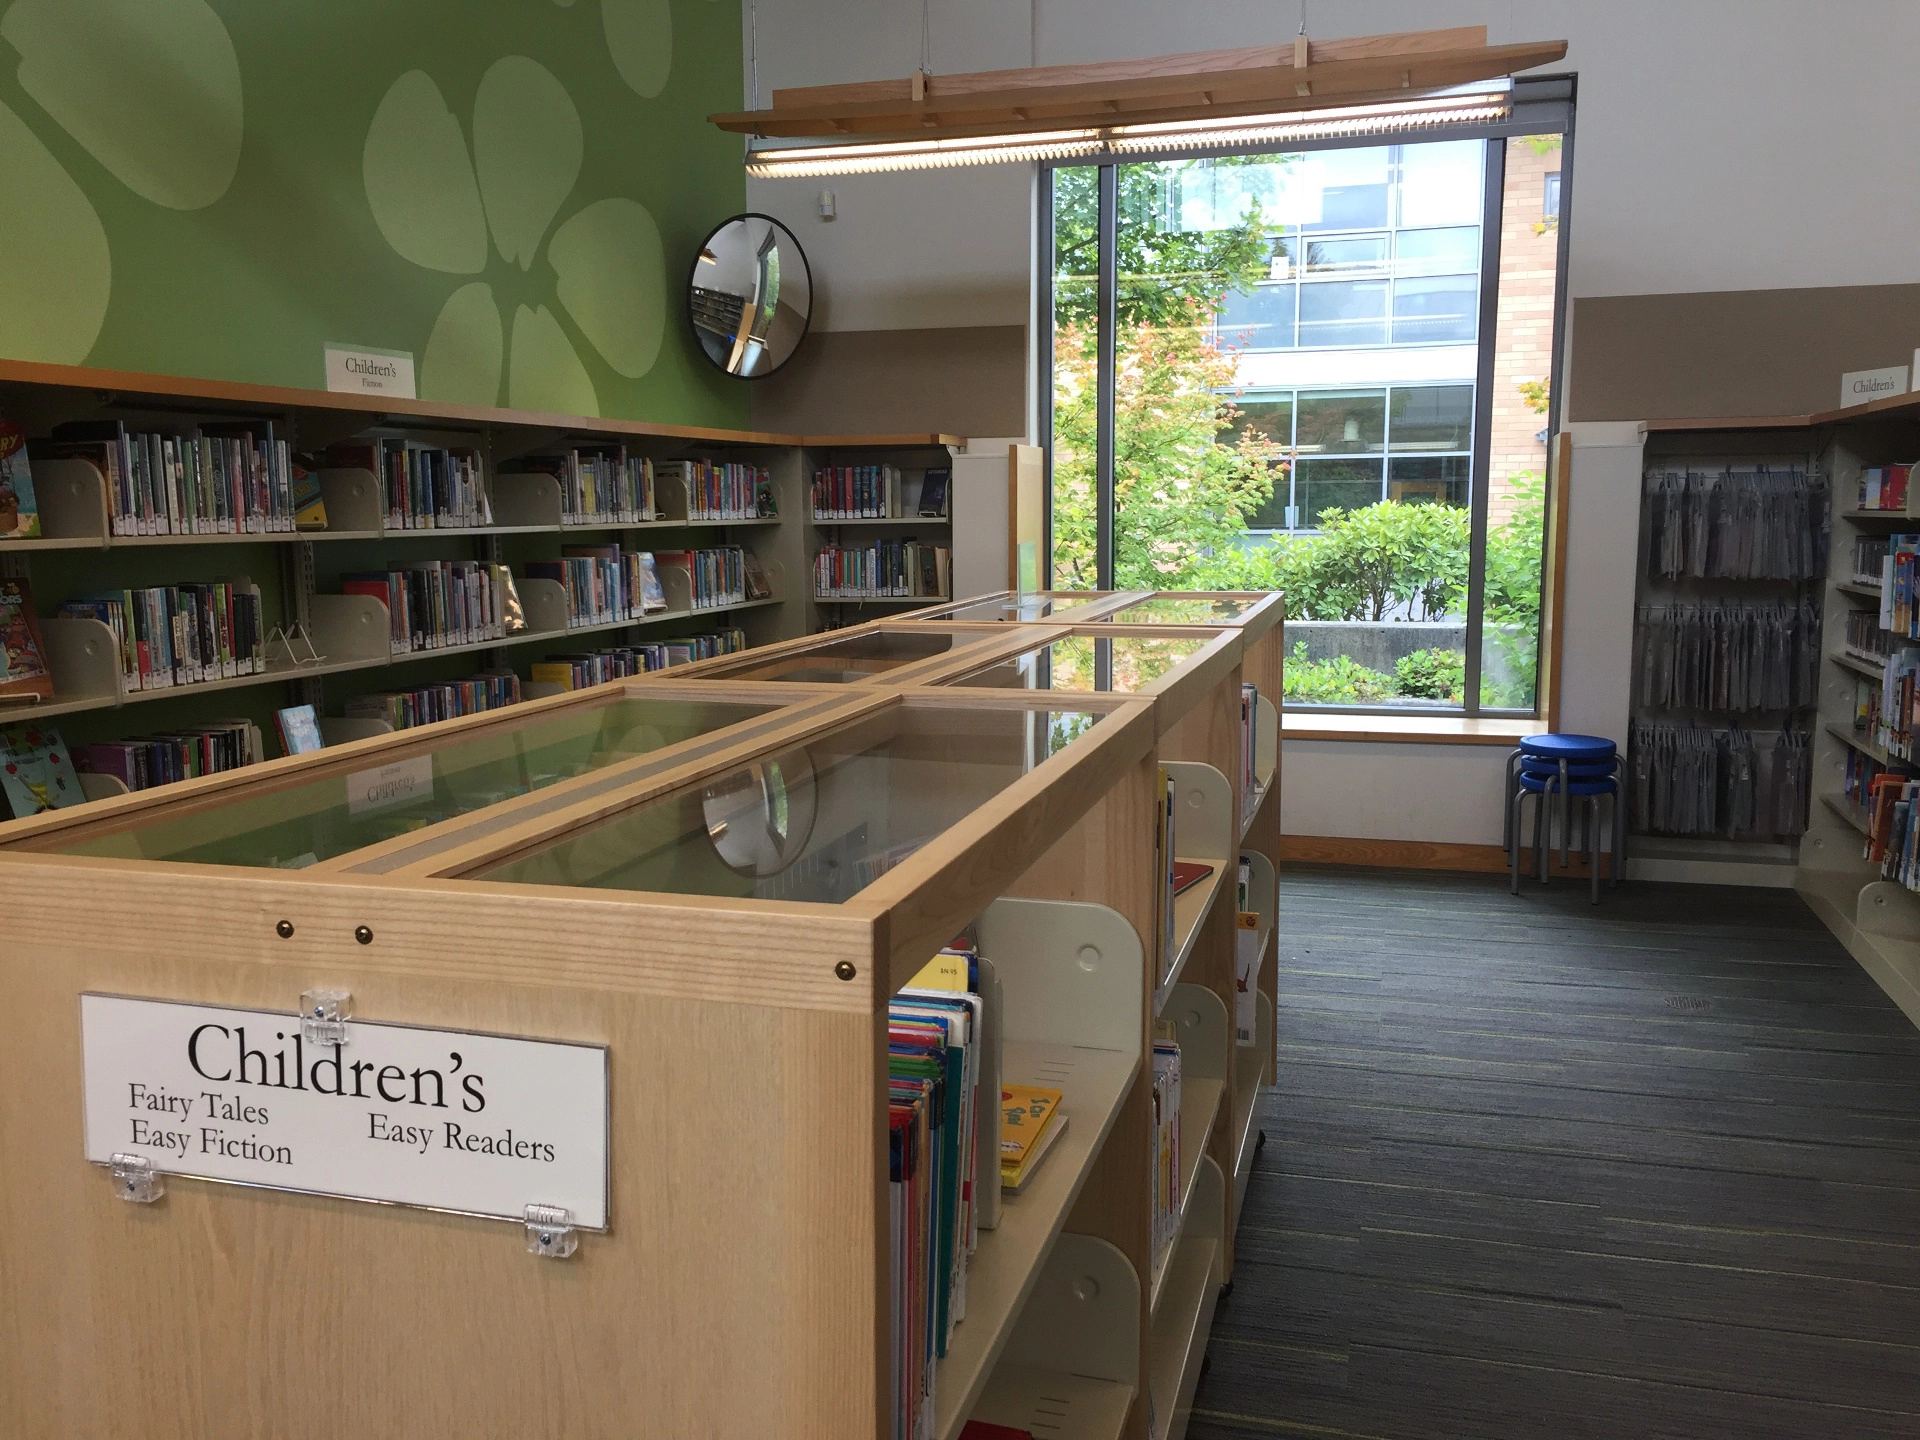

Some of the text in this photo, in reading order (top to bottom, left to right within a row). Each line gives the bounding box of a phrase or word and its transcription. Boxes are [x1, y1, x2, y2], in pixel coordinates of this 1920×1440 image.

[345, 358, 396, 377] Children's
[361, 378, 383, 388] Fiction
[1853, 377, 1894, 393] Children's
[188, 1024, 487, 1113] Children's
[128, 1083, 269, 1126] Fairy Tales
[131, 1119, 293, 1165] Easy Fiction
[367, 1113, 556, 1163] Easy Readers
